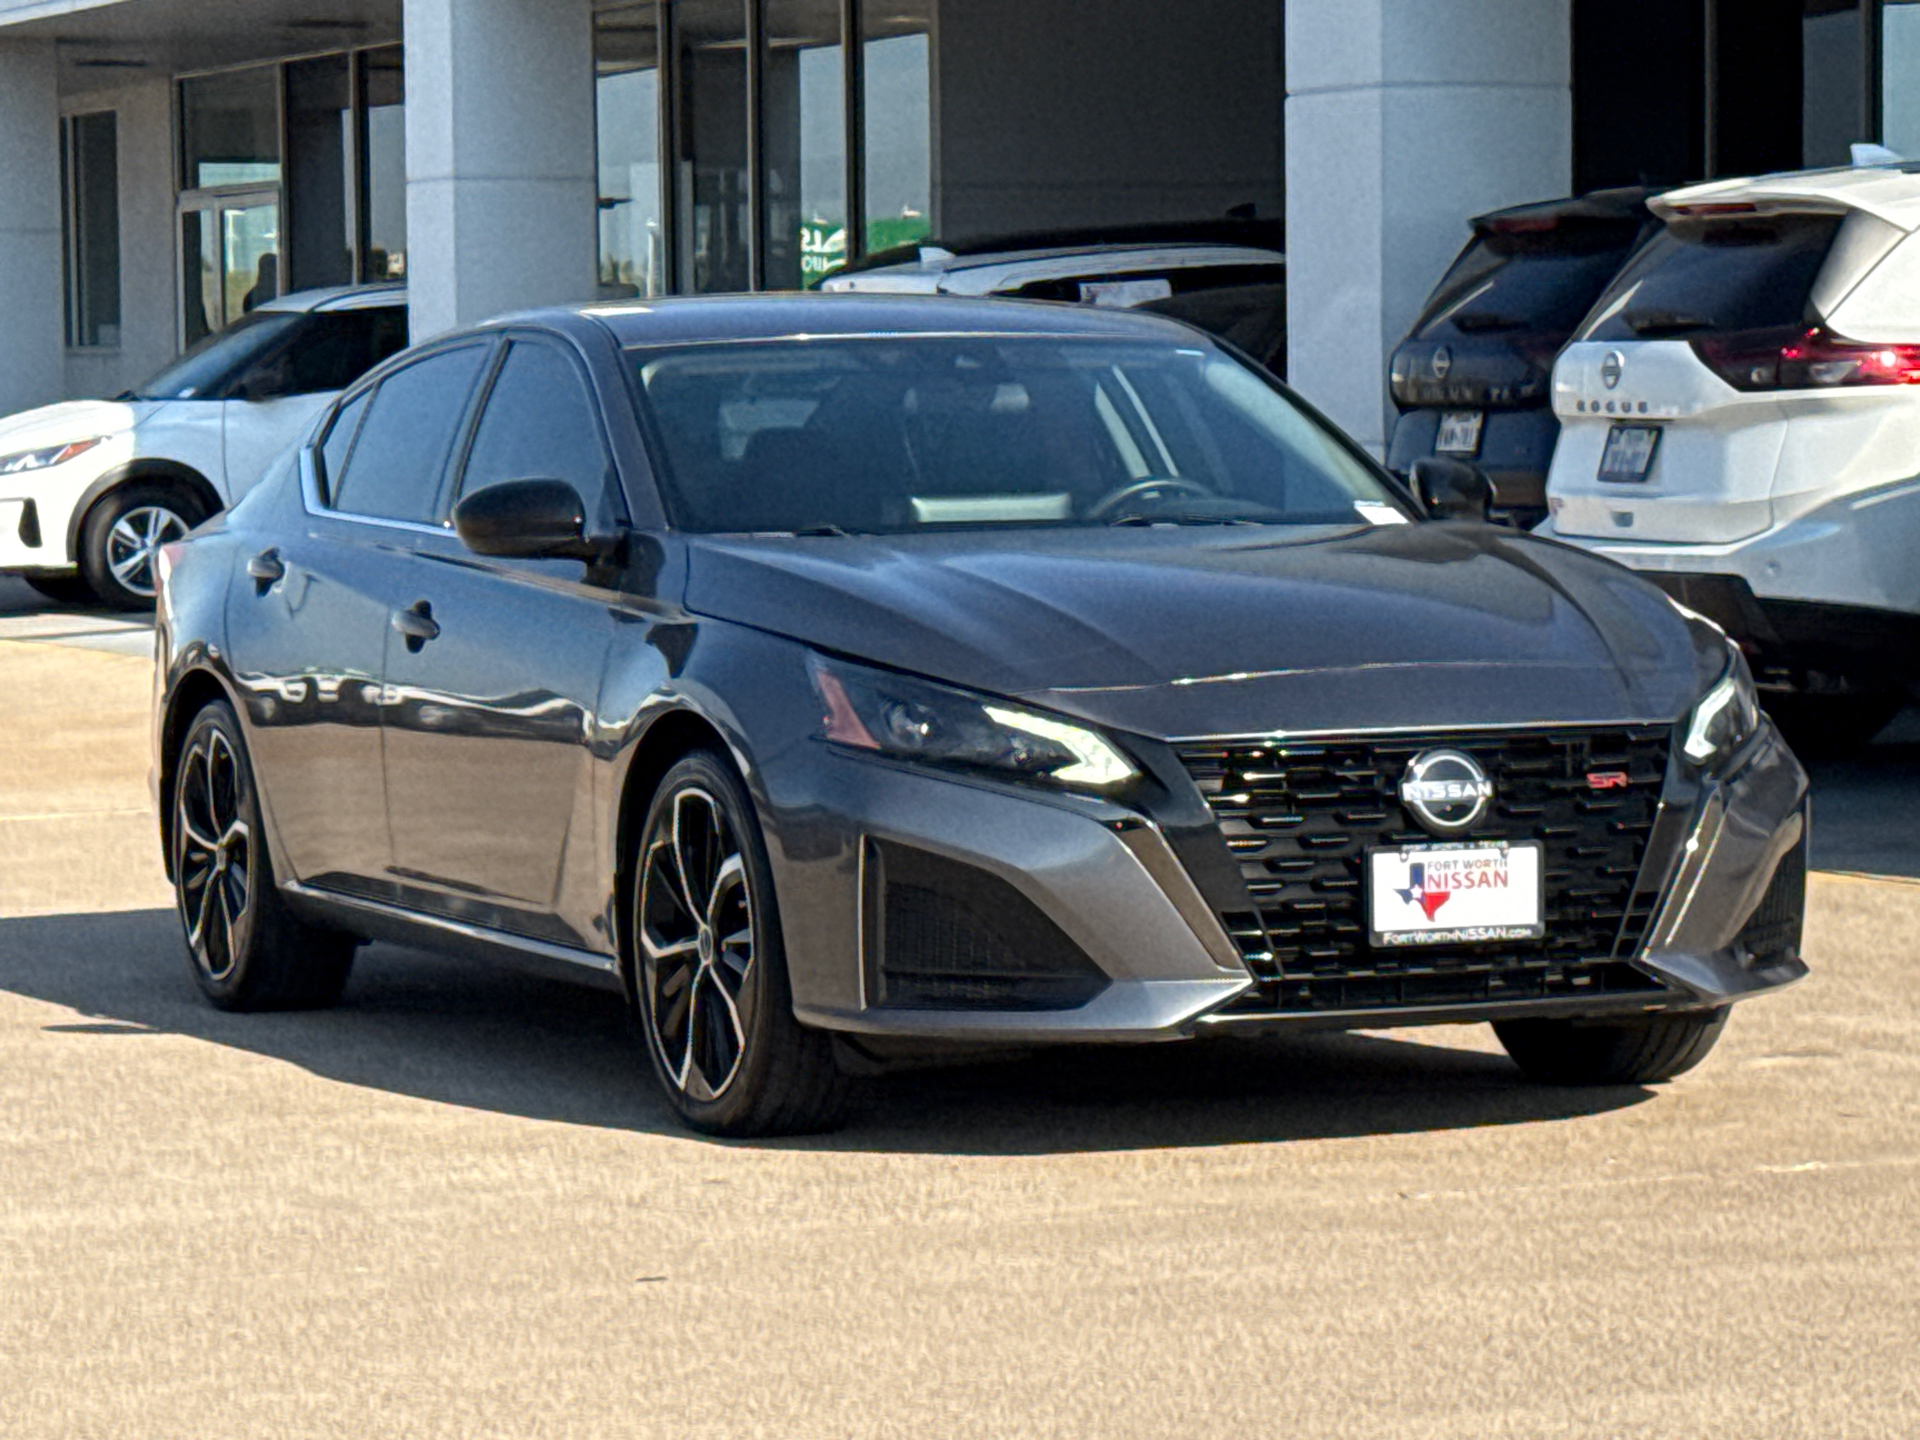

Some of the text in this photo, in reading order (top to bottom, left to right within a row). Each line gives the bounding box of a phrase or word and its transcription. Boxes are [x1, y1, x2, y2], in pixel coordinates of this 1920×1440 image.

[1587, 772, 1628, 788] SR
[1402, 780, 1493, 802] NISSAN
[1427, 858, 1508, 871] FORT WORTH
[1427, 870, 1508, 890] NISSAN
